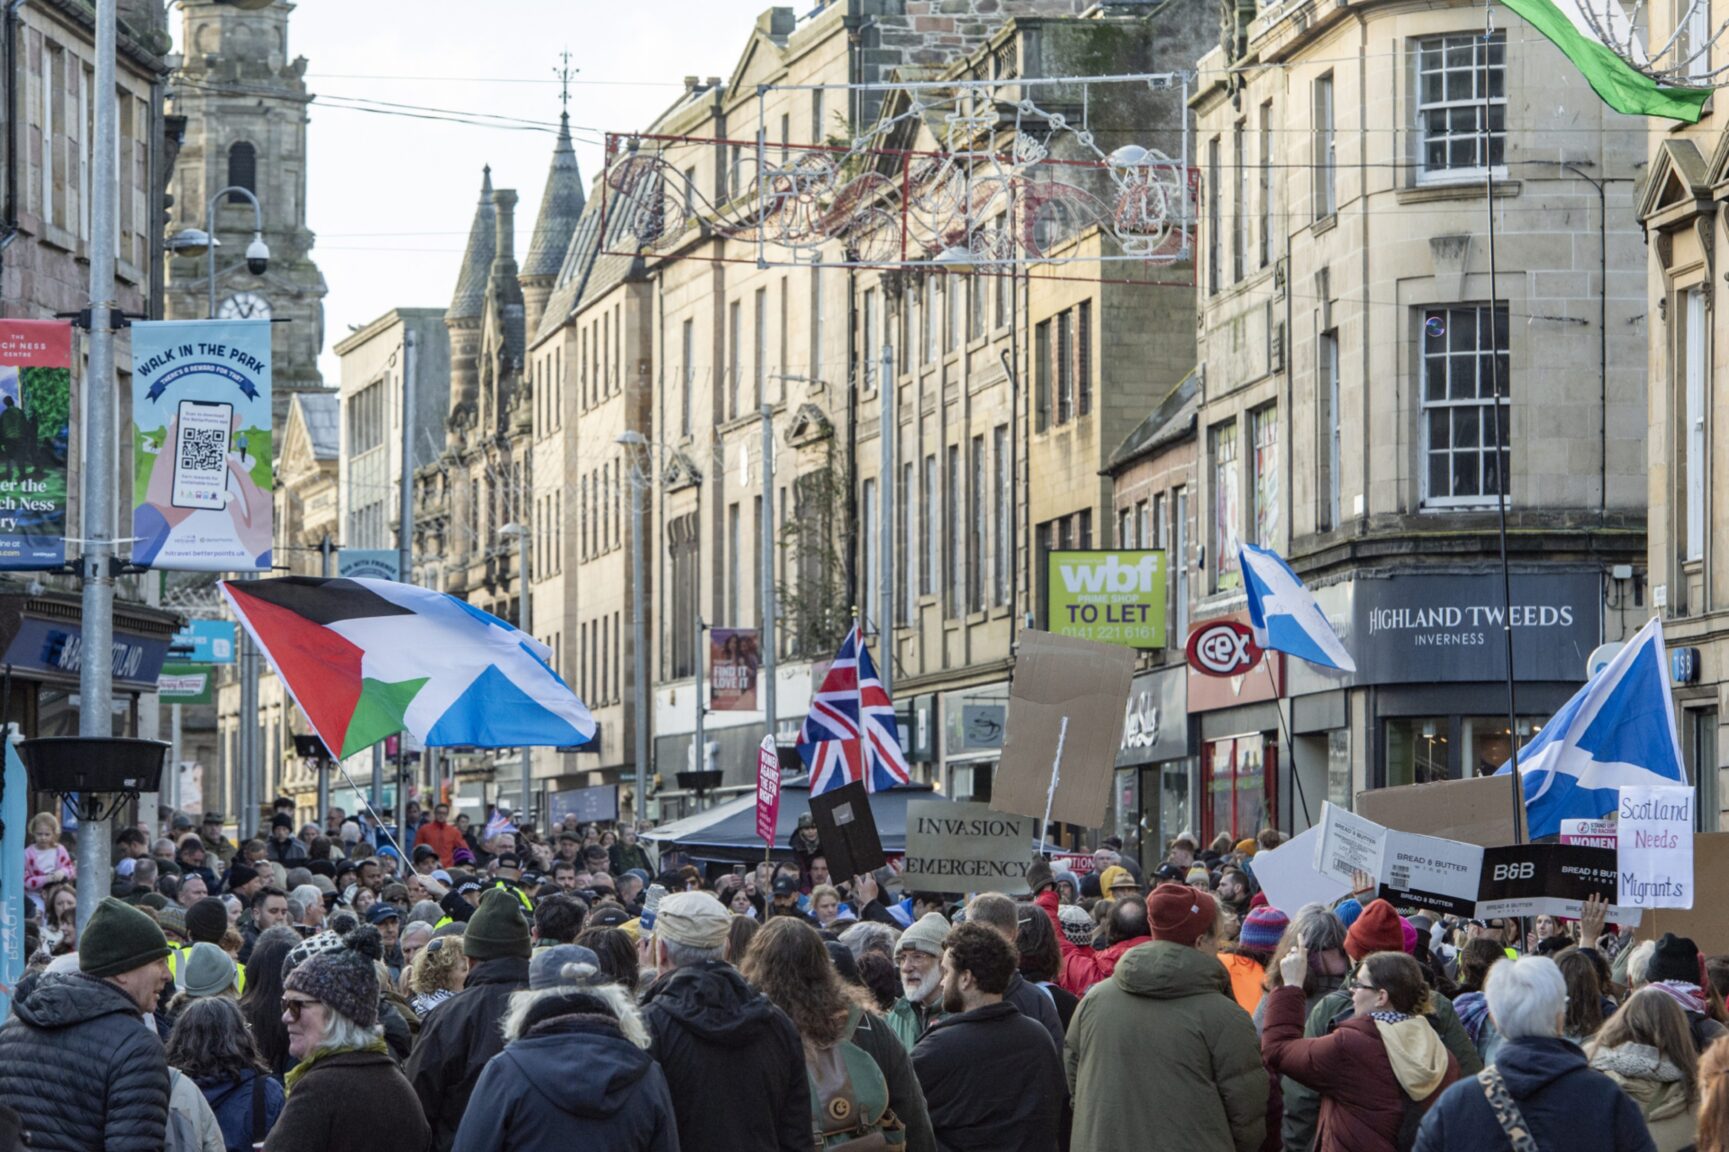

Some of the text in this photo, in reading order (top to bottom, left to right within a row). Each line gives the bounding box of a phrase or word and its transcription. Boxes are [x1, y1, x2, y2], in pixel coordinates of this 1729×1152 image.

[0, 342, 47, 350] CH NESS
[137, 343, 266, 377] WALK IN THE PARK
[190, 364, 215, 372] REWARD
[216, 366, 229, 375] FOR
[21, 478, 48, 492] the
[20, 496, 56, 512] Ness
[1, 517, 18, 532] ry
[1060, 555, 1158, 593] wbf
[1077, 594, 1140, 603] PRIME SHOP
[1065, 604, 1151, 624] TO LET
[1369, 608, 1462, 637] HIGHLAND
[1465, 605, 1574, 627] TWEEDS
[1096, 626, 1120, 639] 221
[1124, 626, 1156, 639] 6161
[1415, 632, 1485, 646] INVERNESS
[713, 665, 748, 677] FIND IT
[1673, 655, 1691, 675] TSB
[713, 677, 749, 689] LOVE IT
[1620, 797, 1689, 822] Scotland
[917, 817, 1021, 837] INVASION
[1569, 836, 1616, 849] WOMEN
[1635, 829, 1679, 849] Needs
[905, 857, 1031, 878] EMERGENCY
[1396, 853, 1426, 864] BREAD
[1435, 860, 1468, 872] BUTTER
[1493, 862, 1536, 882] B&B
[1561, 865, 1592, 875] BREAD
[1600, 869, 1618, 878] BUT
[1579, 875, 1614, 885] wines
[1621, 872, 1684, 905] Migrants
[1400, 893, 1422, 901] BREAD
[1429, 898, 1454, 908] BUTTER
[8, 895, 18, 960] BEAUTY
